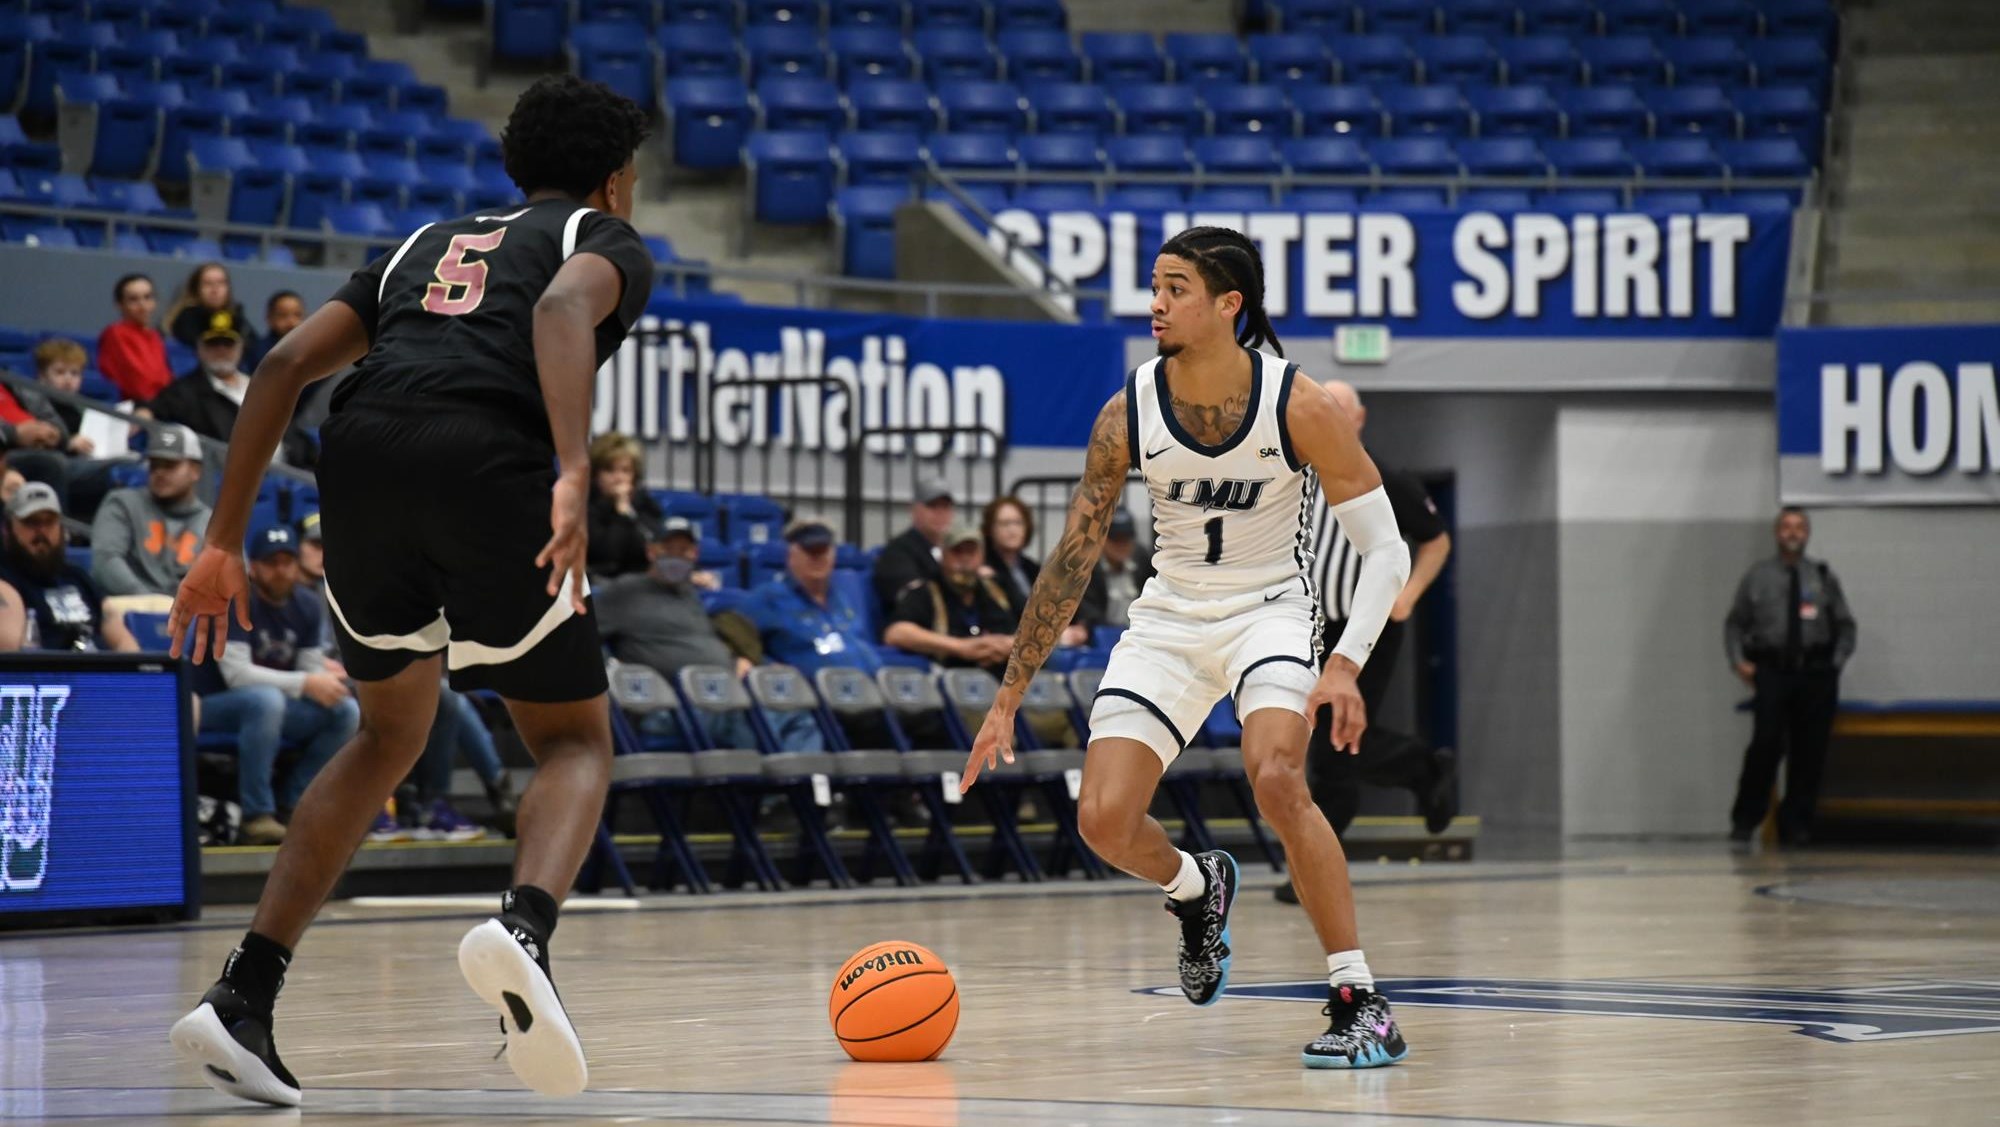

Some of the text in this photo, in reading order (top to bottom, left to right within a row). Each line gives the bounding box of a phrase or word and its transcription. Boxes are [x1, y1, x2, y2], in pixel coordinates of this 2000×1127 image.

[421, 226, 507, 316] 5
[987, 208, 1750, 318] SPLTER SPIRIT
[1259, 447, 1280, 459] SAC
[1164, 477, 1276, 513] LMU
[1204, 516, 1224, 564] 1
[840, 949, 923, 991] Wilson
